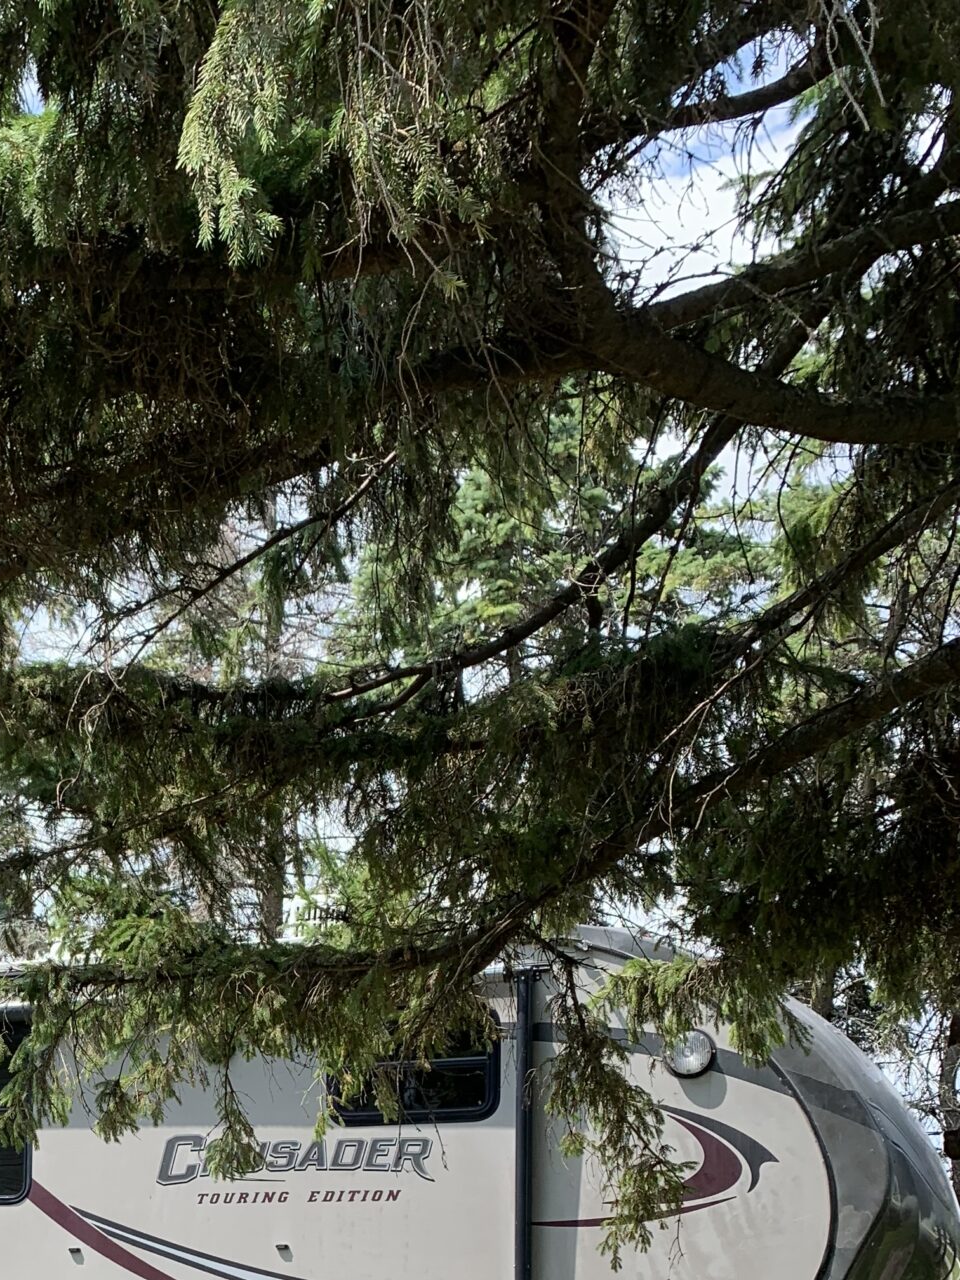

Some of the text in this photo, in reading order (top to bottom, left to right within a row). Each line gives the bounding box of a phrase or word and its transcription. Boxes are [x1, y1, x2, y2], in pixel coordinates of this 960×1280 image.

[156, 1134, 435, 1186] CSADER
[197, 1189, 401, 1205] TOURING EDITION
